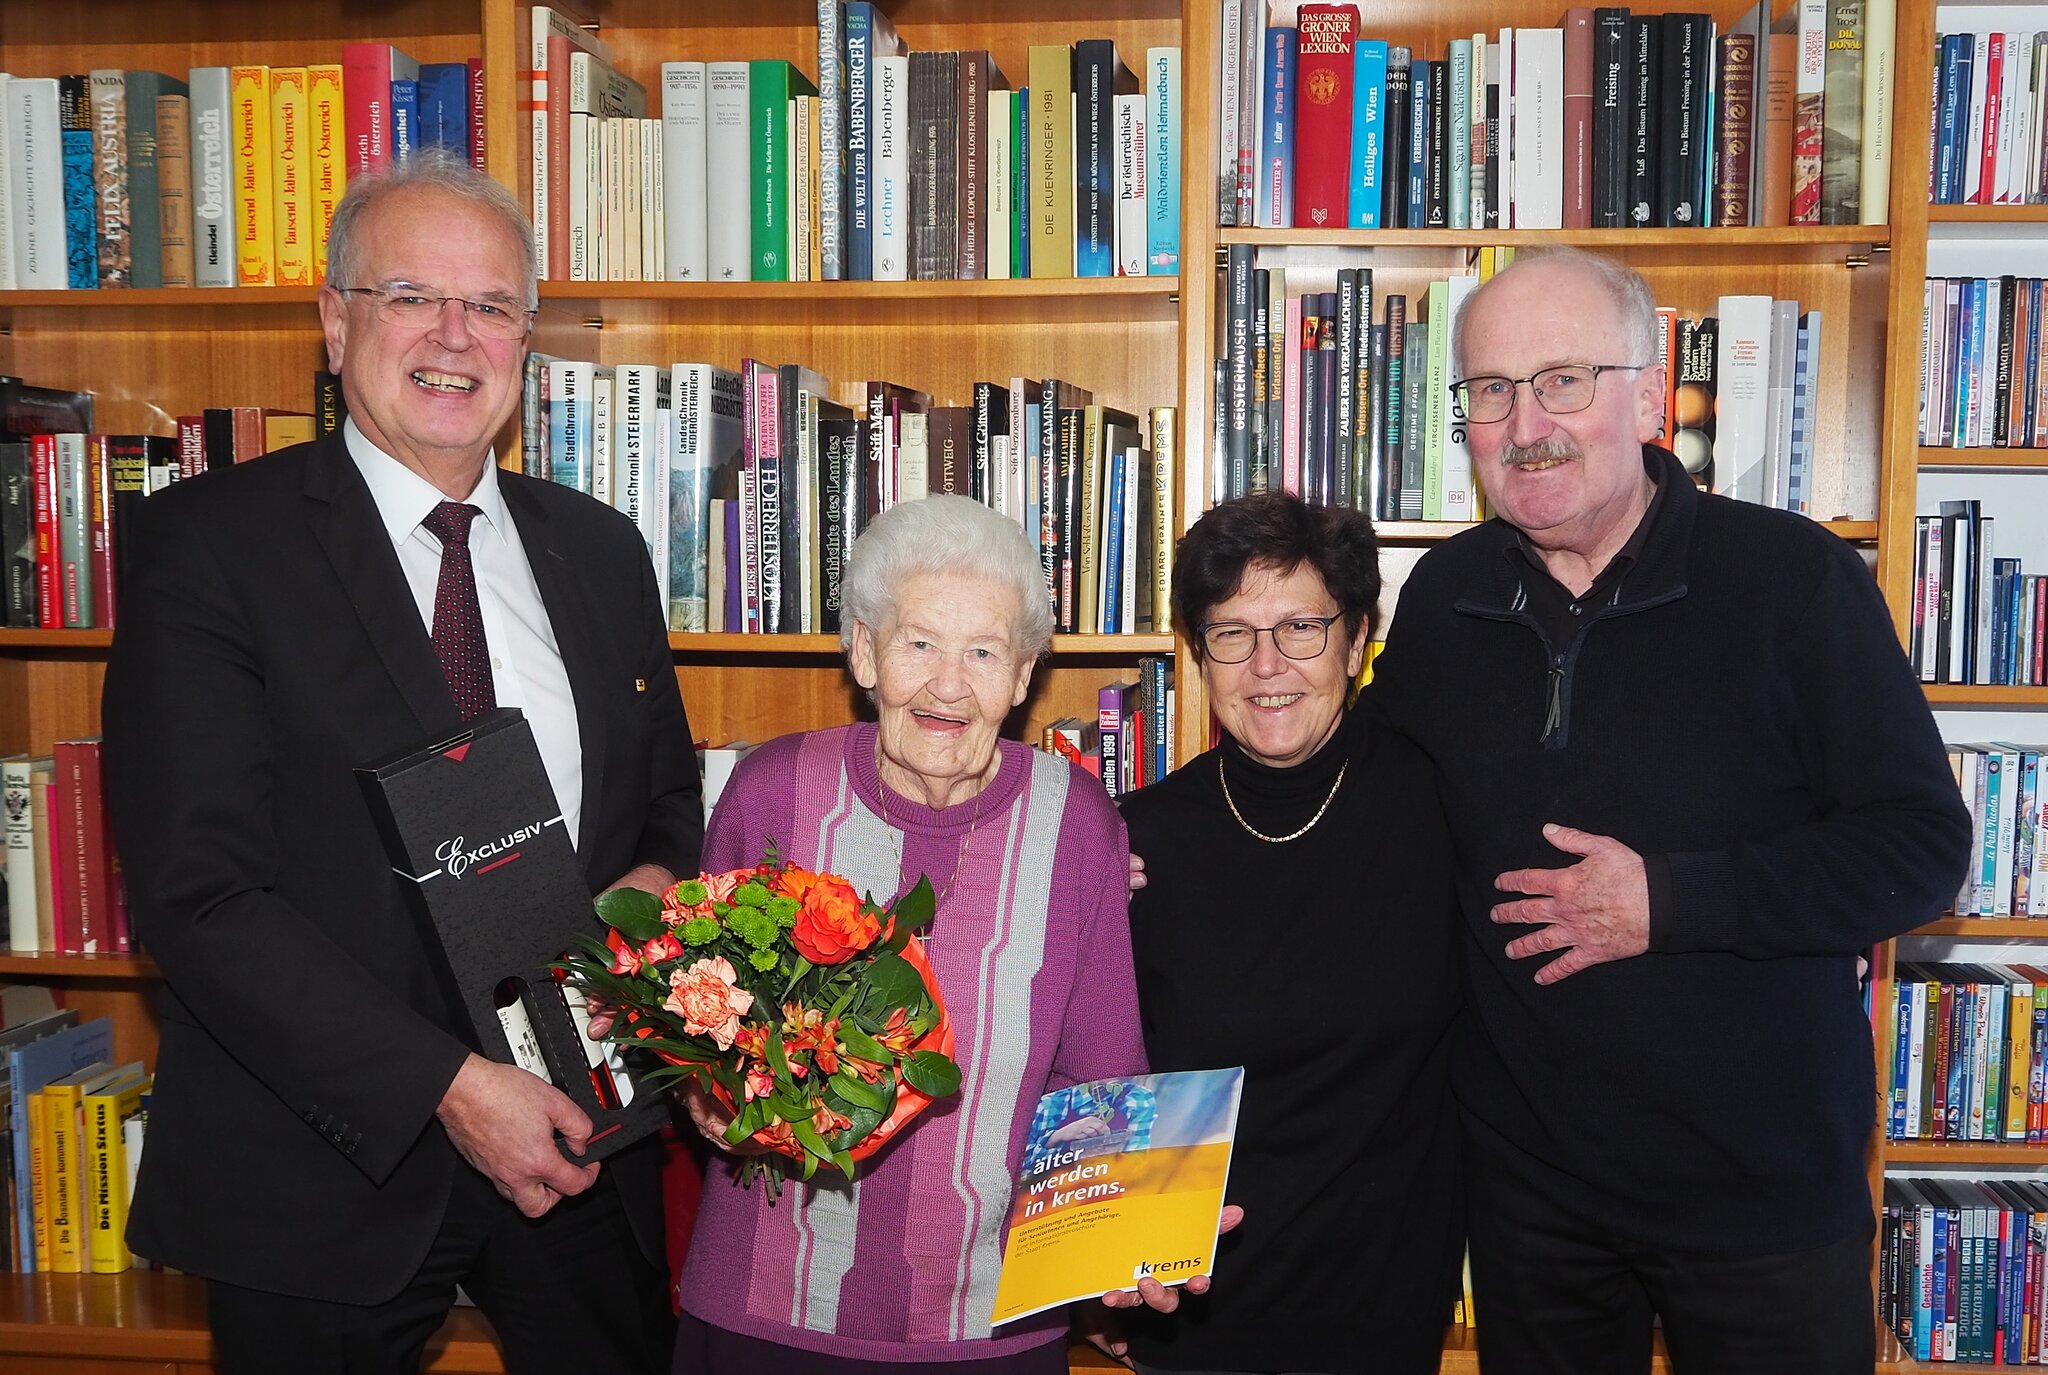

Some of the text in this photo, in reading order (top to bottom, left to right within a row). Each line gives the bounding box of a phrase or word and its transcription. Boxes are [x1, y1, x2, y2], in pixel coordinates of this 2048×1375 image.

[1301, 13, 1352, 22] DAS GROSSE
[1301, 21, 1351, 33] GRONER
[1835, 7, 1858, 15] Ernst
[1226, 5, 1238, 82] BÜRGERMEISTER
[1300, 42, 1350, 54] LEXIKON
[1309, 33, 1342, 43] WIEN
[1991, 41, 2001, 59] Wii
[1226, 84, 1235, 121] WIENER
[1414, 80, 1424, 98] WIEN
[1604, 63, 1619, 108] Freising
[1636, 23, 1649, 177] Maß Das Bistum Freising im Mittelalter
[1680, 23, 1692, 156] Das Bistum Freising in der Neuzeit
[317, 100, 332, 159] Österreich
[369, 101, 381, 156] österreich
[848, 36, 866, 229] DIE WELT DER BABENBERGER
[1412, 99, 1424, 163] VERBRECHERISCHES
[1453, 52, 1465, 172] Sagen aus Niederösterreich
[882, 65, 895, 238] Lechner Babenberger
[1121, 104, 1132, 201] Der österreichische
[1133, 120, 1145, 201] Museumsführer
[1363, 86, 1378, 188] Heiliges Wien
[99, 93, 121, 241] FELIX AUSTRIA
[196, 109, 223, 219] Österreich
[240, 99, 256, 244] Tausend Jahre Österreich
[280, 102, 297, 249] Tausend Jahre Österreich
[320, 162, 332, 195] Jahre
[1043, 89, 1054, 235] DIE KUENRINGER 1981
[797, 99, 809, 281] BEGEGNUNG DER VÖLKER IN ÖSTERREICH
[208, 224, 219, 265] Kleindel
[572, 226, 584, 278] Österreich
[1356, 285, 1370, 437] Verlassene Orte in Niederösterreich
[1388, 359, 1401, 382] VON
[1681, 324, 1692, 381] Das politische
[1690, 349, 1701, 381] System
[1697, 333, 1708, 381] Österreichs
[564, 370, 576, 463] StadtChronik WIEN
[678, 381, 689, 455] LandesChronik
[688, 369, 699, 455] NIEDERÖSTERREICH
[1043, 389, 1055, 447] GAMING
[1388, 384, 1400, 422] STADT
[870, 394, 884, 462] Stift Melk
[1010, 391, 1021, 475] Stift Herzogenburg
[1387, 425, 1399, 445] DIE
[36, 443, 46, 473] Schatten
[37, 474, 47, 484] im
[976, 446, 988, 470] Stift
[1155, 418, 1169, 492] KREMS
[37, 484, 48, 510] Männer
[1043, 449, 1055, 518] KARTAUSE
[1449, 490, 1465, 503] DK
[38, 510, 49, 523] Die
[744, 466, 757, 597] REISE IN DIE GESCHICHTE
[760, 468, 779, 602] KLOSTERREICH
[826, 435, 841, 611] Geschichte des Landes
[39, 532, 49, 554] Leitner
[12, 565, 23, 609] HABSBURG
[1157, 550, 1167, 592] EDUARD
[1156, 668, 1165, 707] Raumfahrt
[1156, 714, 1165, 745] Raketen
[1987, 794, 1998, 828] Nicolas
[434, 821, 542, 880] EXCLUSIV
[1985, 829, 1996, 849] Petit
[1953, 997, 1962, 1052] Schneewittchen
[1977, 996, 1987, 1019] Winnie
[31, 1147, 44, 1208] Anekdoten
[95, 1103, 111, 1230] Die Mission Sixtus
[1029, 1162, 1109, 1196] werden
[1032, 1147, 1085, 1176] älter
[55, 1176, 69, 1226] Bosniaken
[1018, 1217, 1063, 1238] Unterstützung
[1077, 1206, 1111, 1219] Angebote
[1024, 1180, 1126, 1218] in krems.
[1066, 1220, 1080, 1228] und
[1080, 1212, 1121, 1225] Angehörige.
[59, 1229, 70, 1243] Die
[1140, 1256, 1202, 1276] krems
[1921, 1263, 1933, 1309] Geschichte
[1961, 1265, 1970, 1281] DIE
[1974, 1265, 1983, 1281] DIE
[1986, 1240, 1997, 1290] DIE HANSE
[1958, 1283, 1970, 1338] KREUZZÜGE
[1972, 1283, 1983, 1337] KREUZZÜGE
